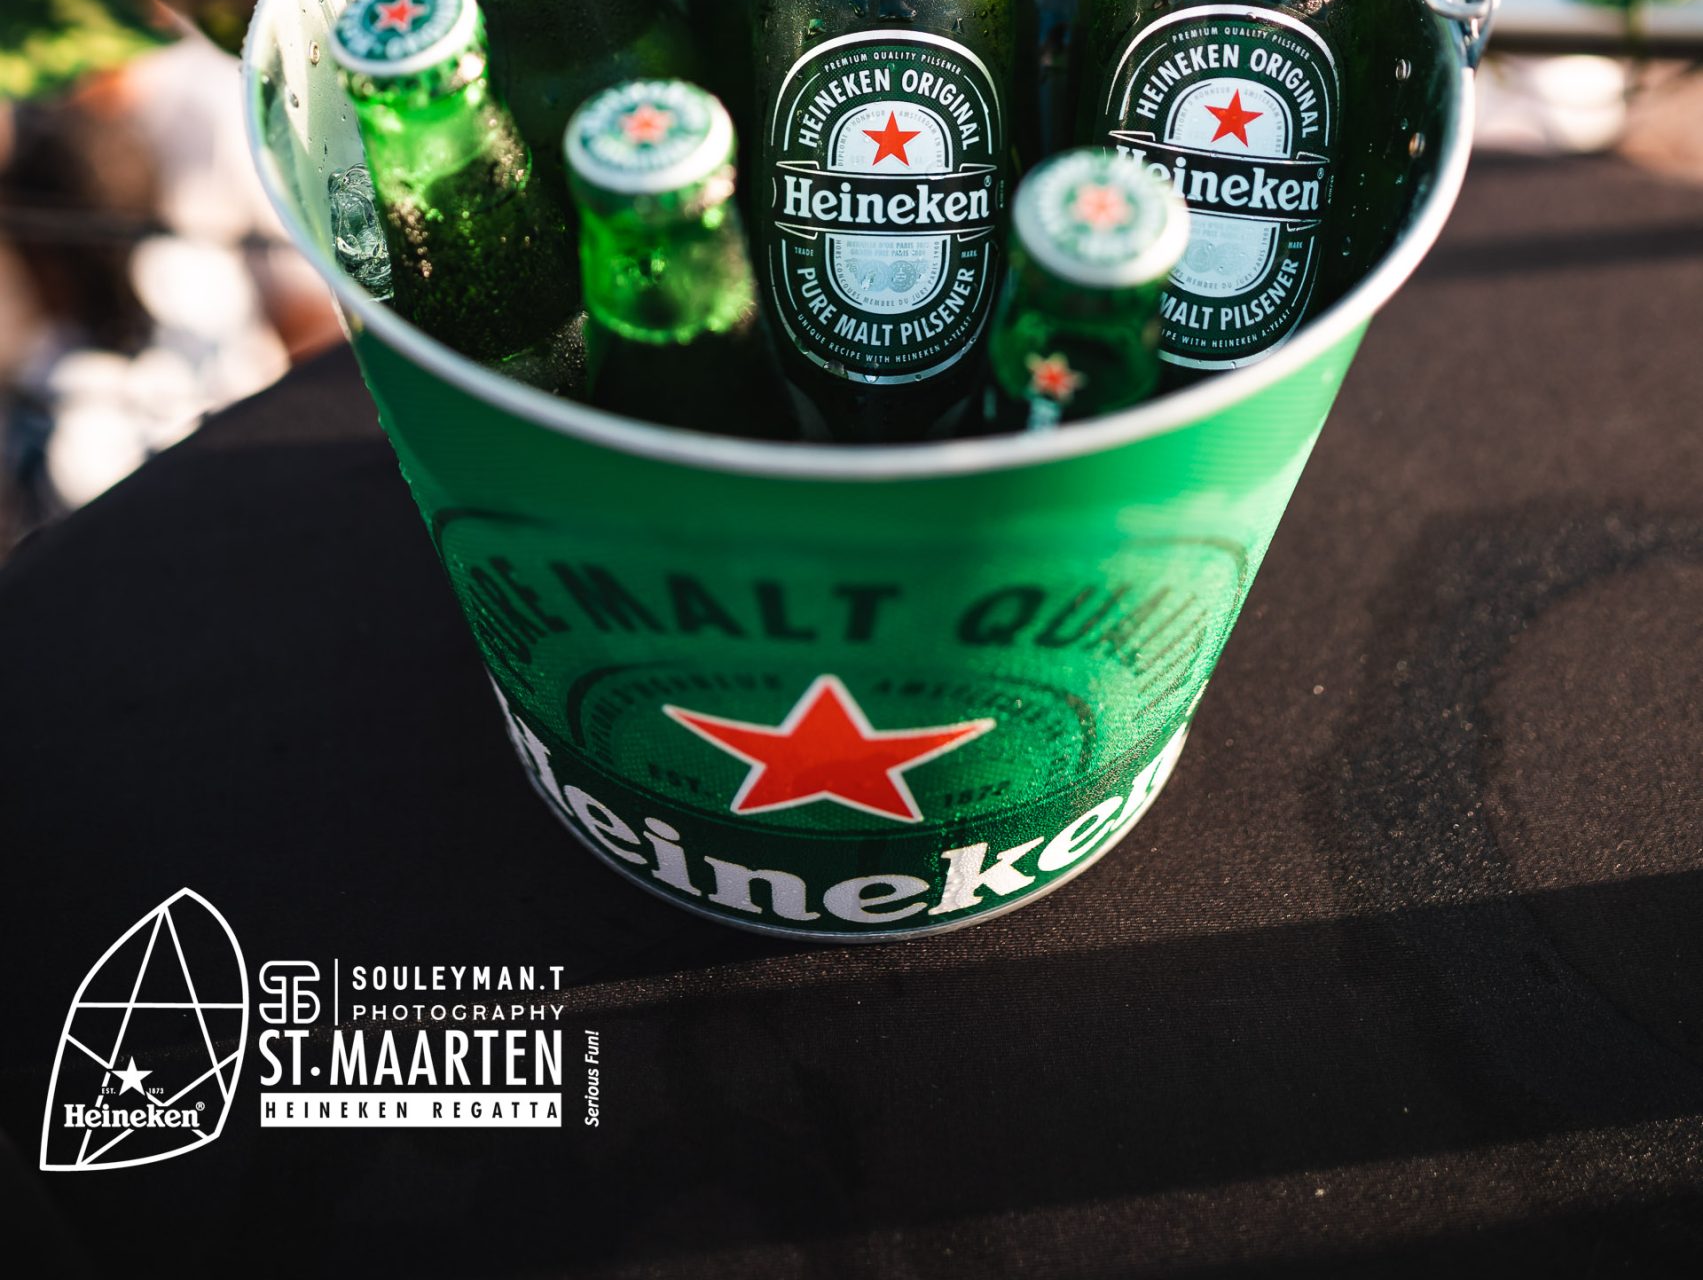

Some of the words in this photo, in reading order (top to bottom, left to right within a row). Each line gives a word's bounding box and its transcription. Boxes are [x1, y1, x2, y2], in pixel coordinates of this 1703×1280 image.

[824, 53, 868, 73] PREMIUM
[873, 51, 917, 61] QUALITY
[920, 54, 962, 76] PILSENER
[1171, 26, 1219, 43] PREMIUM
[1224, 26, 1269, 40] QUALITY
[1271, 34, 1311, 61] PILSENER
[798, 68, 891, 149] HEINEKEN
[901, 69, 980, 151] ORIGINAL
[1135, 43, 1240, 120] HEINEKEN
[1249, 48, 1319, 139] ORIGINAL
[794, 246, 814, 257] TRADE
[961, 249, 977, 259] MARK
[796, 267, 838, 325] PURE
[833, 313, 893, 347] MALT
[900, 268, 975, 346] PILSENER
[836, 262, 861, 301] CONCOURS
[899, 298, 909, 306] DU
[911, 287, 929, 302] JURY
[927, 261, 939, 286] PARIS
[1159, 291, 1214, 330] MALT
[1220, 258, 1299, 331] PILSENER
[797, 313, 826, 345] UNIQUE
[828, 340, 861, 360] RECIPE
[865, 354, 891, 364] WITH
[895, 344, 941, 363] HEINEKEN
[1181, 336, 1207, 347] WITH
[1211, 334, 1258, 348] HEINEKEN
[547, 560, 902, 645] MALT
